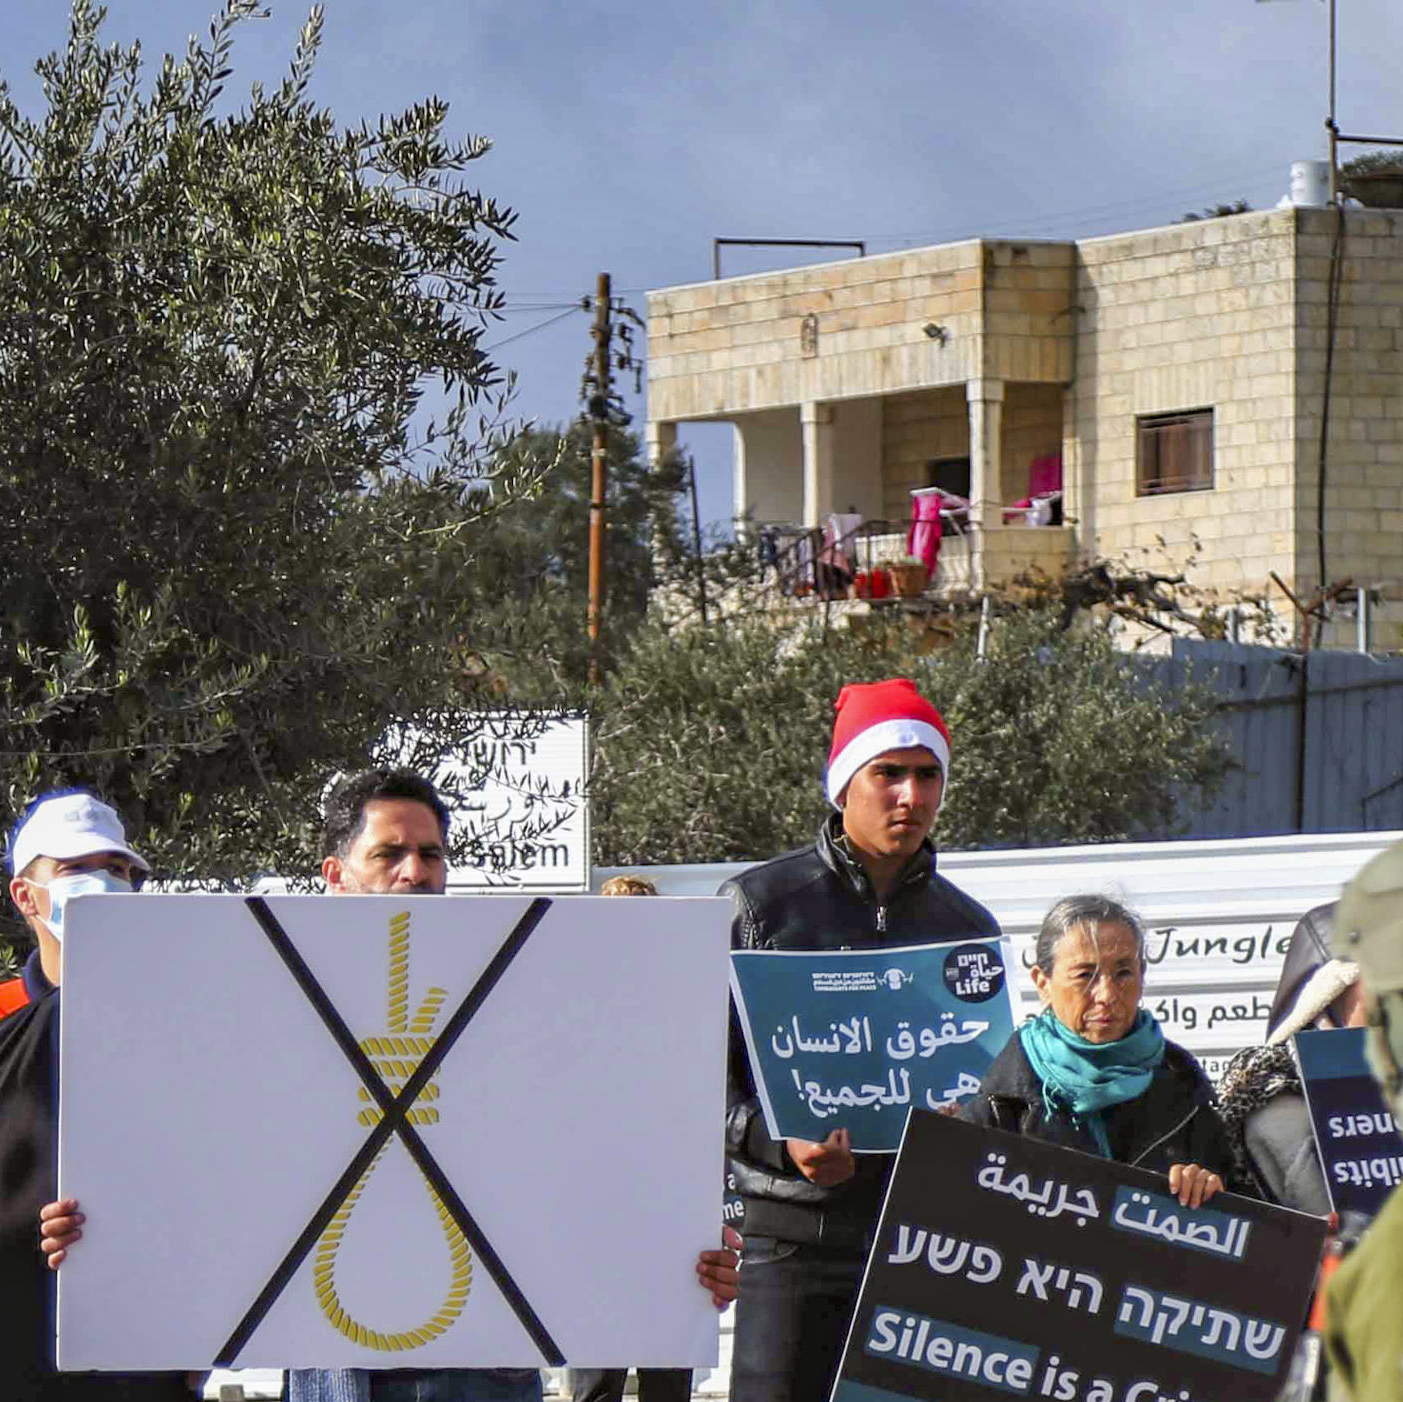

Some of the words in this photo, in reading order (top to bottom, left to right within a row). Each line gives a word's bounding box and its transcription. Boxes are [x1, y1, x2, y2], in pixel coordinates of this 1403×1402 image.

[955, 978, 991, 996] Life
[885, 1012, 990, 1060] حقوق
[791, 1068, 911, 1118] للجميع!
[976, 1151, 1101, 1228] جريمة
[1112, 1191, 1252, 1256] الصمت
[888, 1224, 1003, 1284] פשע
[1015, 1256, 1104, 1314] היא
[1116, 1285, 1286, 1359] שתיקה
[868, 1310, 1034, 1391] Silence
[1040, 1355, 1079, 1402] is
